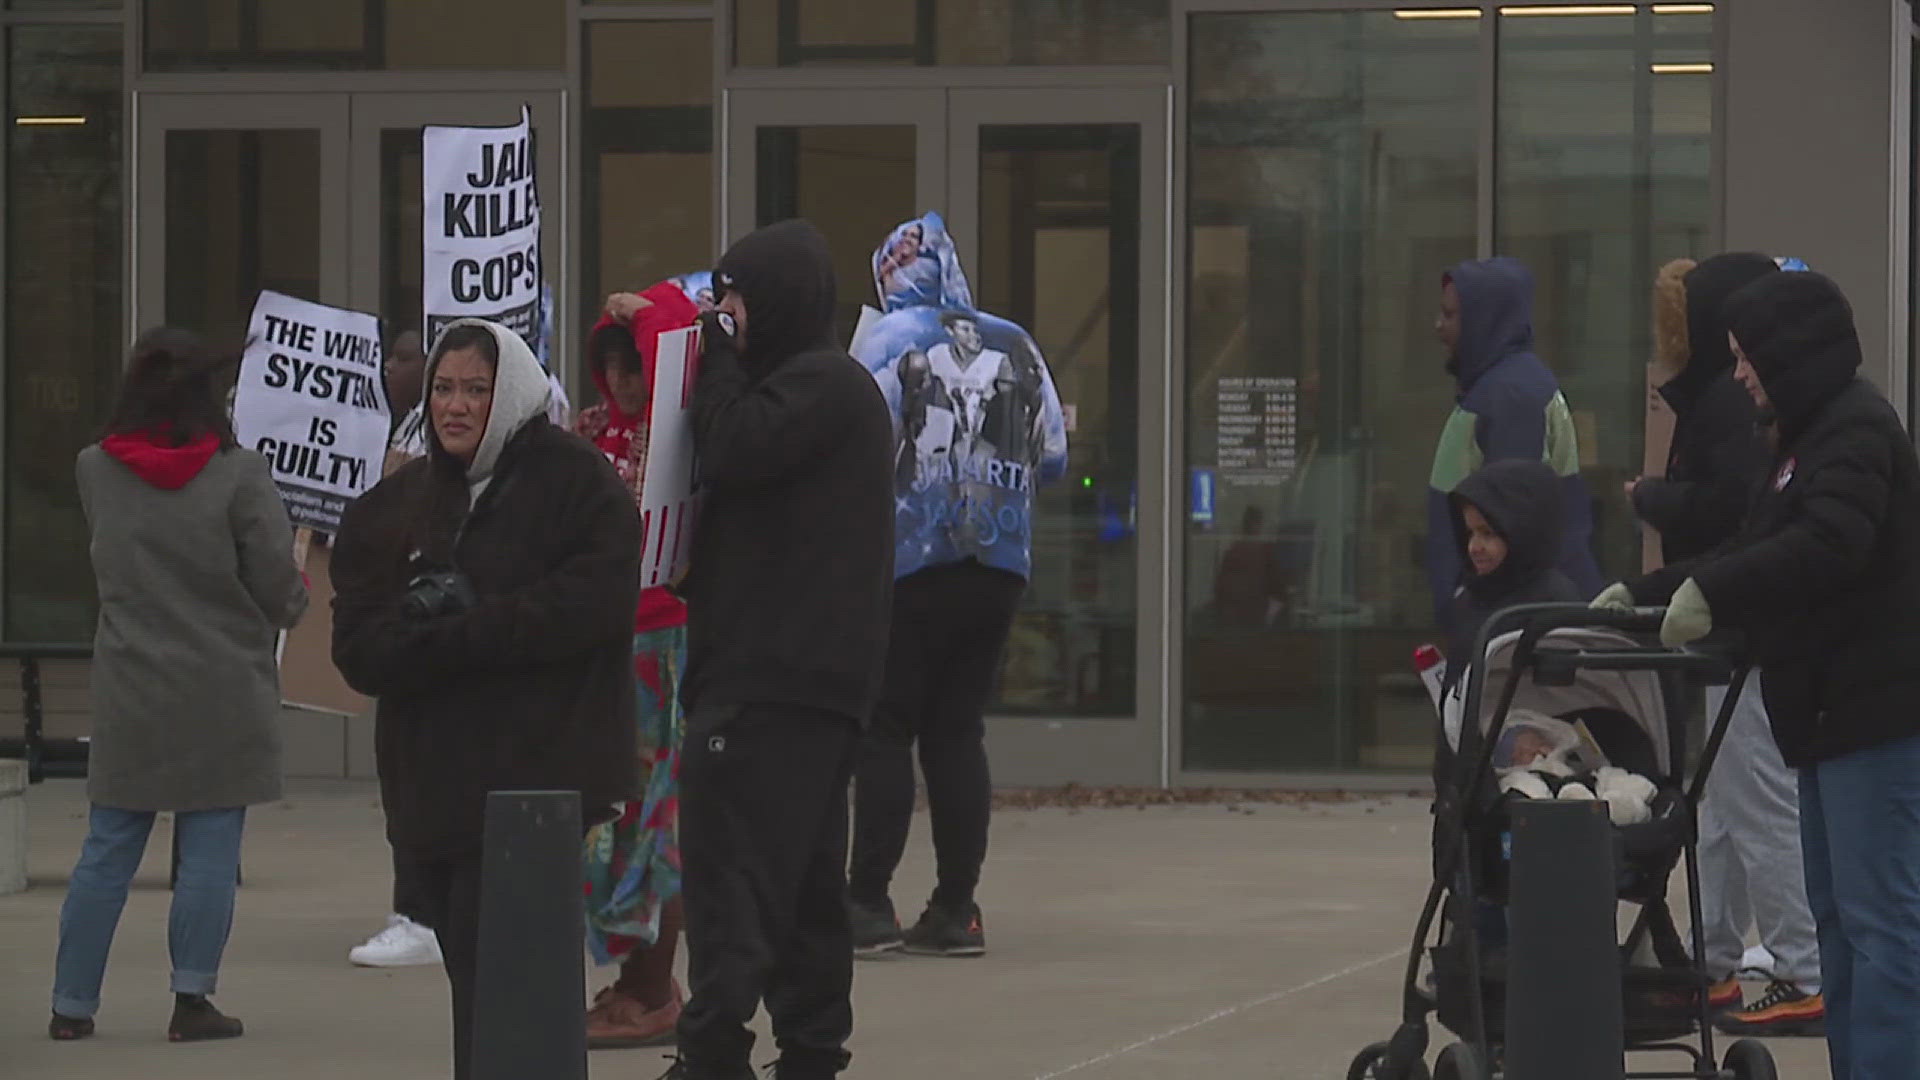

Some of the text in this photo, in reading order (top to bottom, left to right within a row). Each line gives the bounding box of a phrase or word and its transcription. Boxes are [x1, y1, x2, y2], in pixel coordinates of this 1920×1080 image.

[451, 244, 536, 303] COPS
[265, 314, 379, 368] THE WHOLE
[264, 353, 379, 410] SYSTEM
[308, 416, 337, 447] IS
